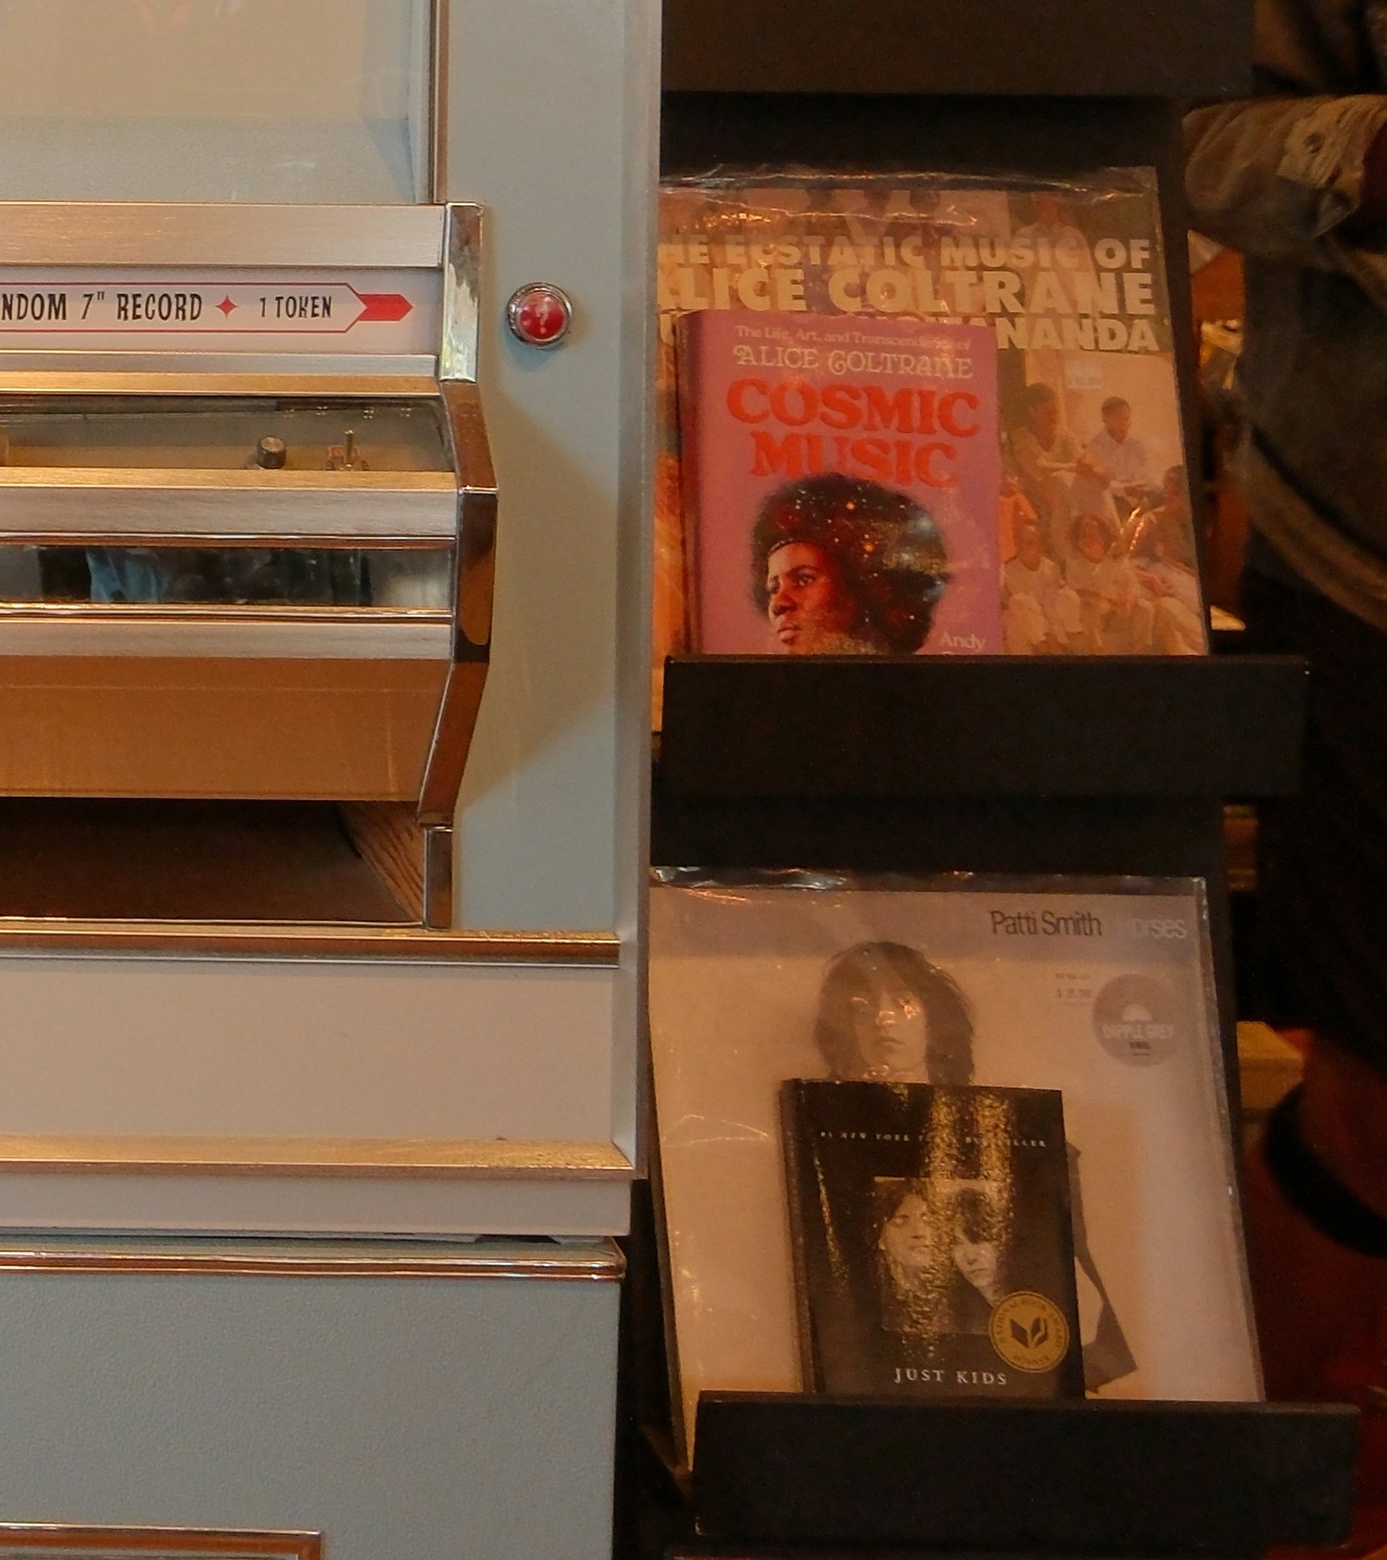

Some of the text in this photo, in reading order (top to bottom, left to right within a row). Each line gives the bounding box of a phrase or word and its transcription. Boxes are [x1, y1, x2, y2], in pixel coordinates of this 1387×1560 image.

[725, 234, 1150, 269] ECSTATIC MUSIC OF
[81, 290, 106, 321] 7"
[116, 292, 204, 322] RECORD
[260, 296, 268, 319] 1
[274, 295, 333, 320] TOKEN
[828, 267, 1156, 315] COLTRANE
[733, 345, 975, 380] ALICE COLTRANE
[727, 378, 981, 438] COSMIC
[750, 431, 958, 489] MUSIC
[990, 910, 1103, 937] Patti Smith
[894, 1367, 1008, 1386] JUST KIDS
